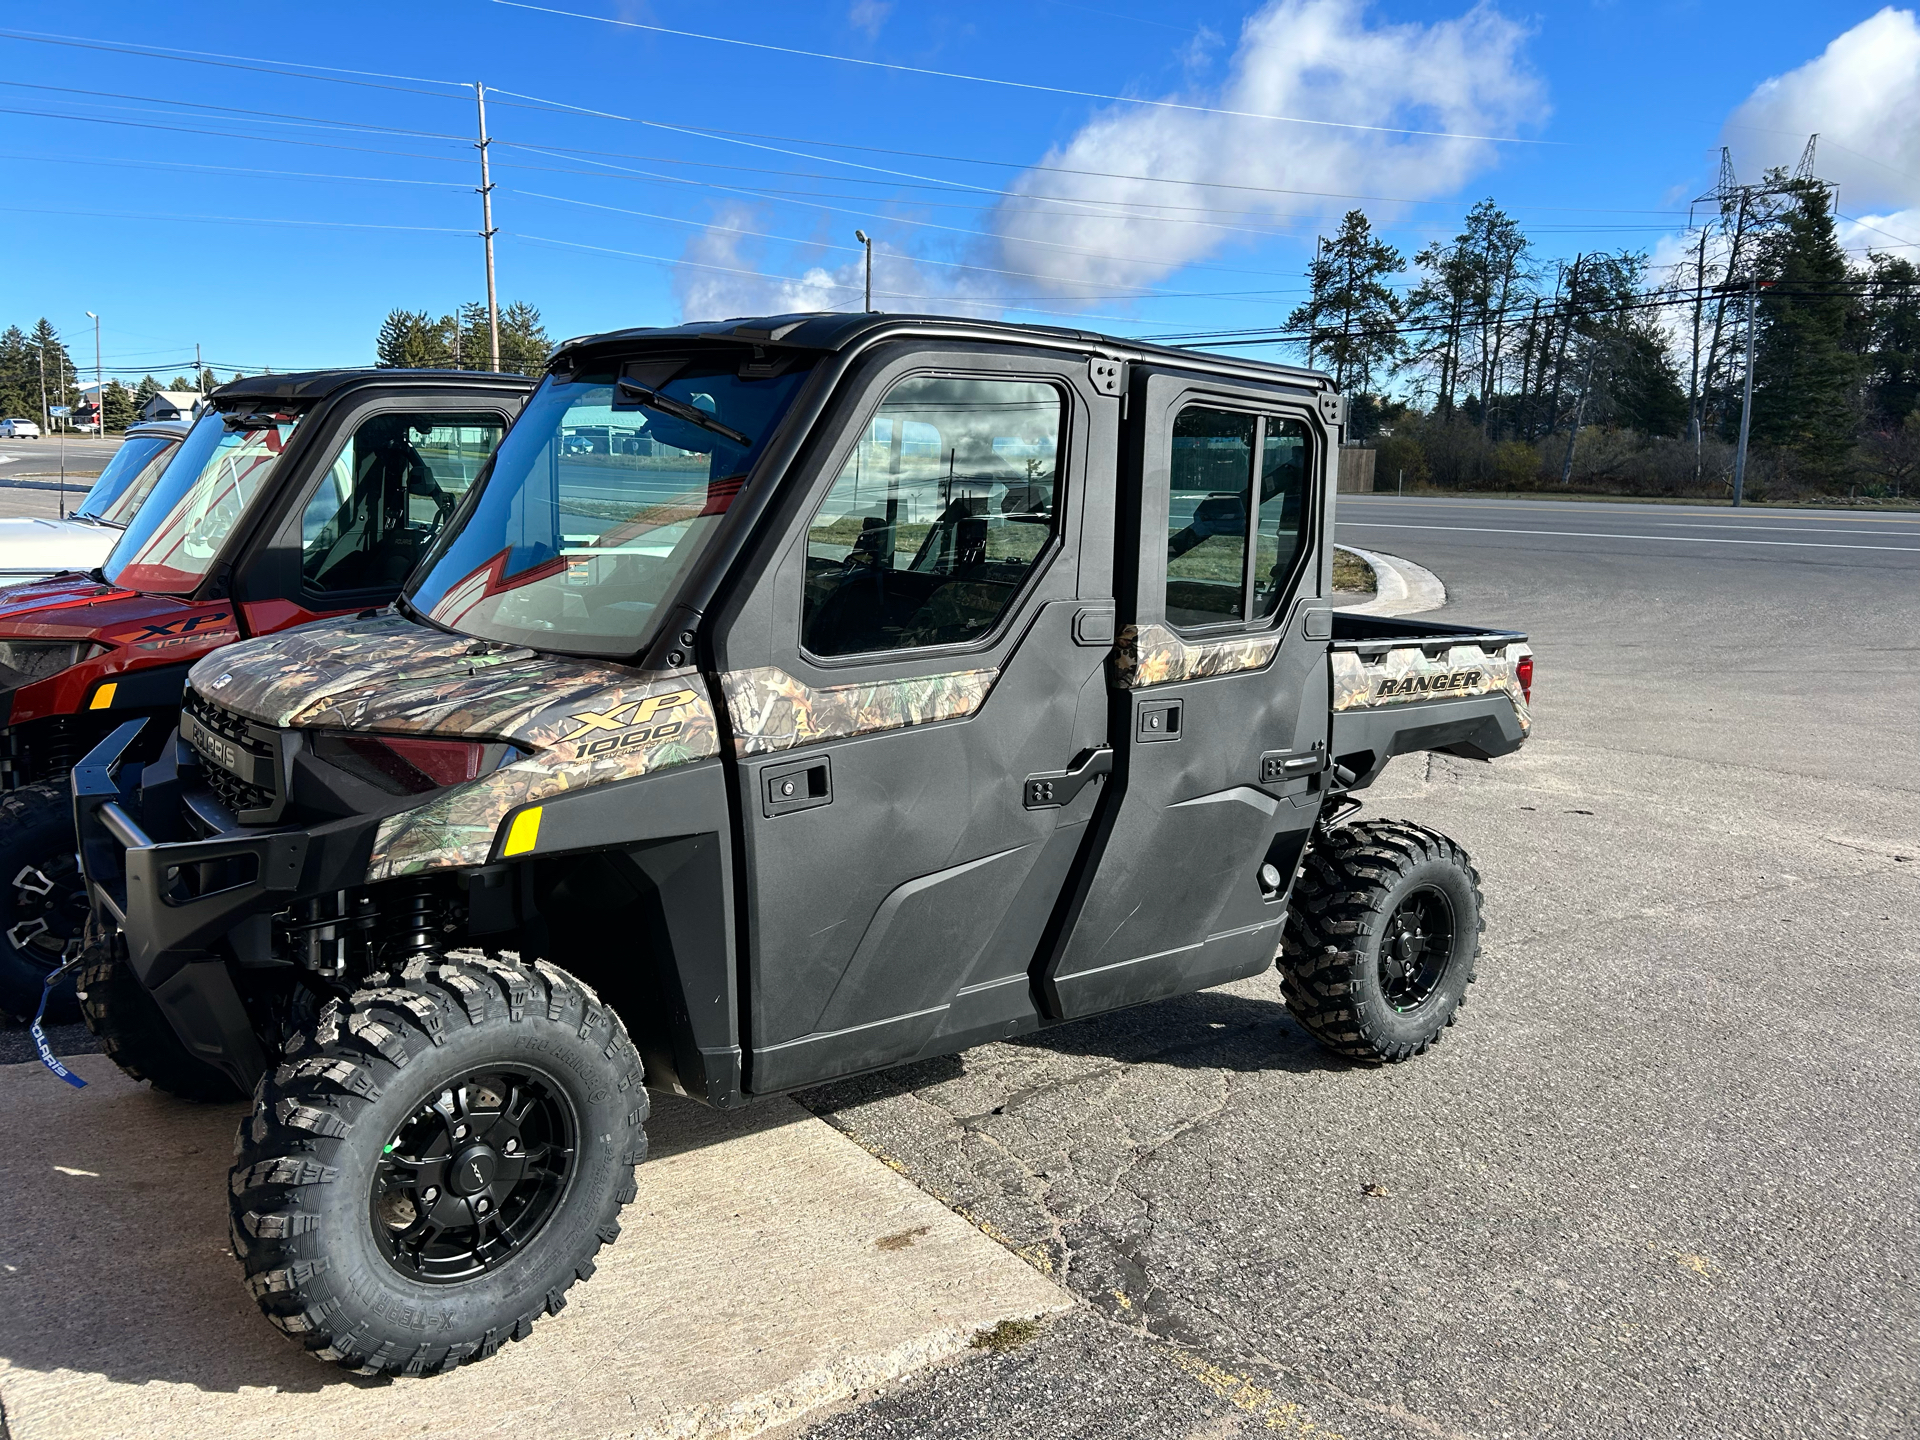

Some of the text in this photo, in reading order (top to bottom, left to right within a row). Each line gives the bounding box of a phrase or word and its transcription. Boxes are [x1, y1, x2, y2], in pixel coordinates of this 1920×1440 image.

[129, 612, 228, 642] XP
[156, 629, 226, 649] 1000
[1375, 670, 1482, 698] RANGER
[549, 688, 700, 745] XP
[192, 723, 235, 768] POLARIS
[574, 720, 685, 759] 1000
[470, 1162, 484, 1184] XP
